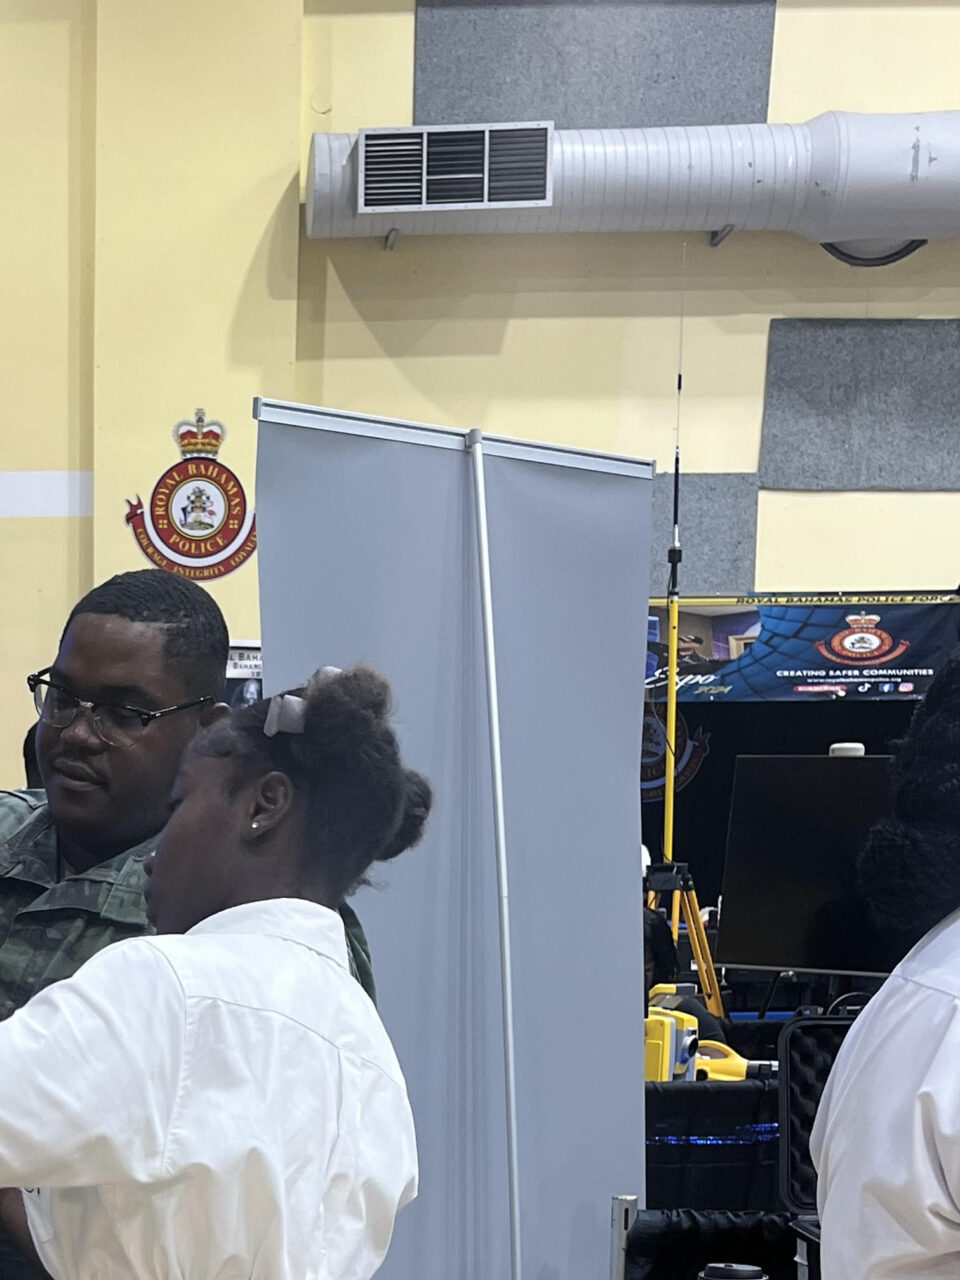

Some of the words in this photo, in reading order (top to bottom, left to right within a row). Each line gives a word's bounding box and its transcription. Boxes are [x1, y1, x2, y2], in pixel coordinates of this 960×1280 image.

[155, 470, 184, 516] ROYAL
[187, 463, 241, 516] BAHAMAS
[169, 533, 227, 554] POLICE
[173, 565, 225, 577] INTEGRITY
[229, 531, 257, 566] LOYALT
[736, 597, 780, 605] ROYAL
[785, 596, 851, 604] BAHAMAS
[856, 595, 910, 603] POLICE
[911, 595, 955, 603] FORCE
[644, 666, 719, 691] Expo
[776, 669, 826, 677] CREATING
[862, 668, 934, 676] COMMUNITIES
